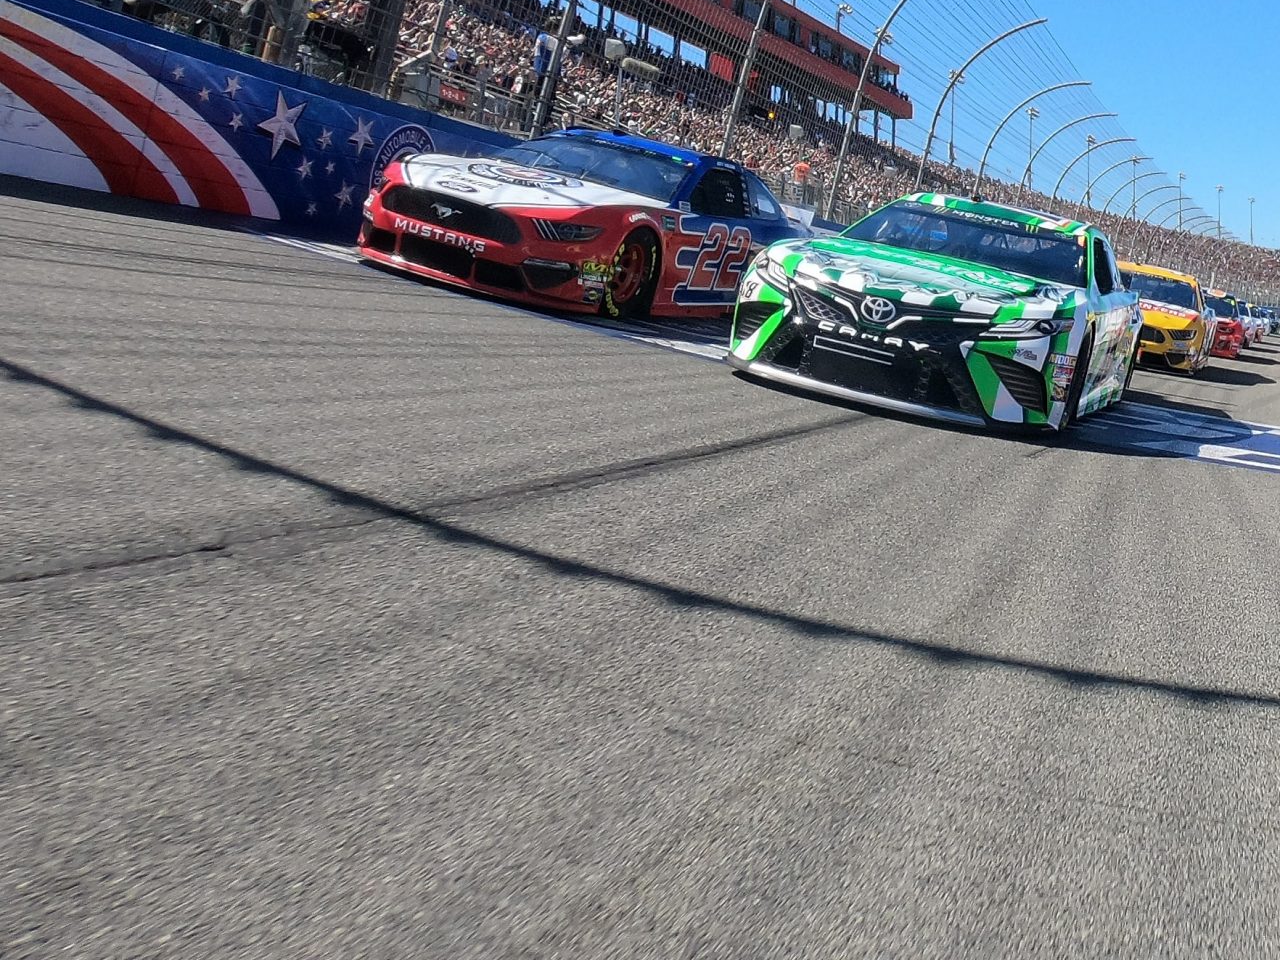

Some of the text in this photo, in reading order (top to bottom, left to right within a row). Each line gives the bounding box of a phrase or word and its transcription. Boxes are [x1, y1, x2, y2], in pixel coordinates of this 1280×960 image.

[383, 130, 425, 164] AUTOMOBILE
[394, 218, 486, 252] MUSTANG
[951, 209, 1020, 229] MONSTER
[687, 223, 752, 291] 22
